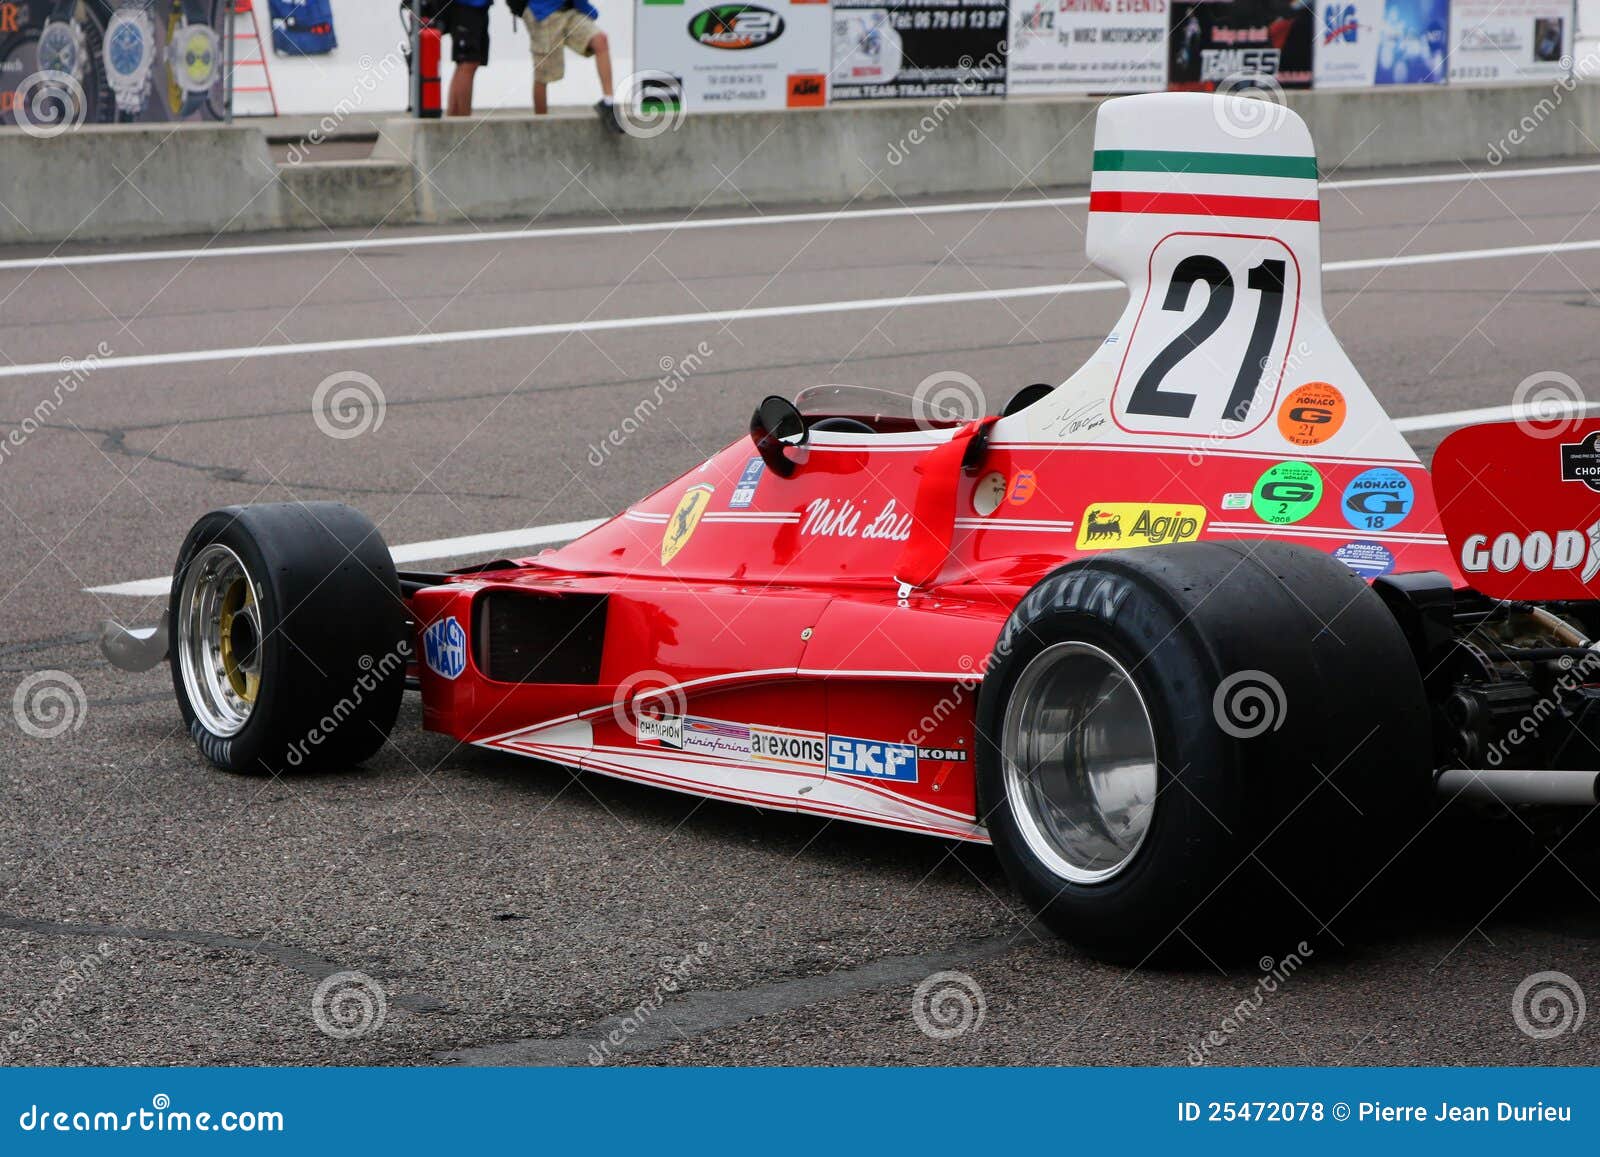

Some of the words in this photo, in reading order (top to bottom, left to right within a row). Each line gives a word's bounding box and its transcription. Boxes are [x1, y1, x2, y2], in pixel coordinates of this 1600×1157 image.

[700, 31, 767, 42] MOTO
[1125, 254, 1286, 422] 21
[1295, 396, 1335, 406] MONACO
[1289, 407, 1333, 424] G
[1261, 482, 1315, 502] G
[1353, 480, 1407, 489] MONACO
[1278, 503, 1288, 514] 2
[1346, 491, 1408, 514] G
[801, 499, 858, 538] Niki
[1129, 511, 1197, 543] Agip
[1365, 516, 1385, 528] 18
[1346, 543, 1383, 551] MONACO
[640, 721, 680, 739] CHAMPION
[684, 736, 752, 754] pininfarina
[752, 733, 824, 763] arexons
[830, 743, 915, 776] SKF
[919, 748, 966, 761] KONI
